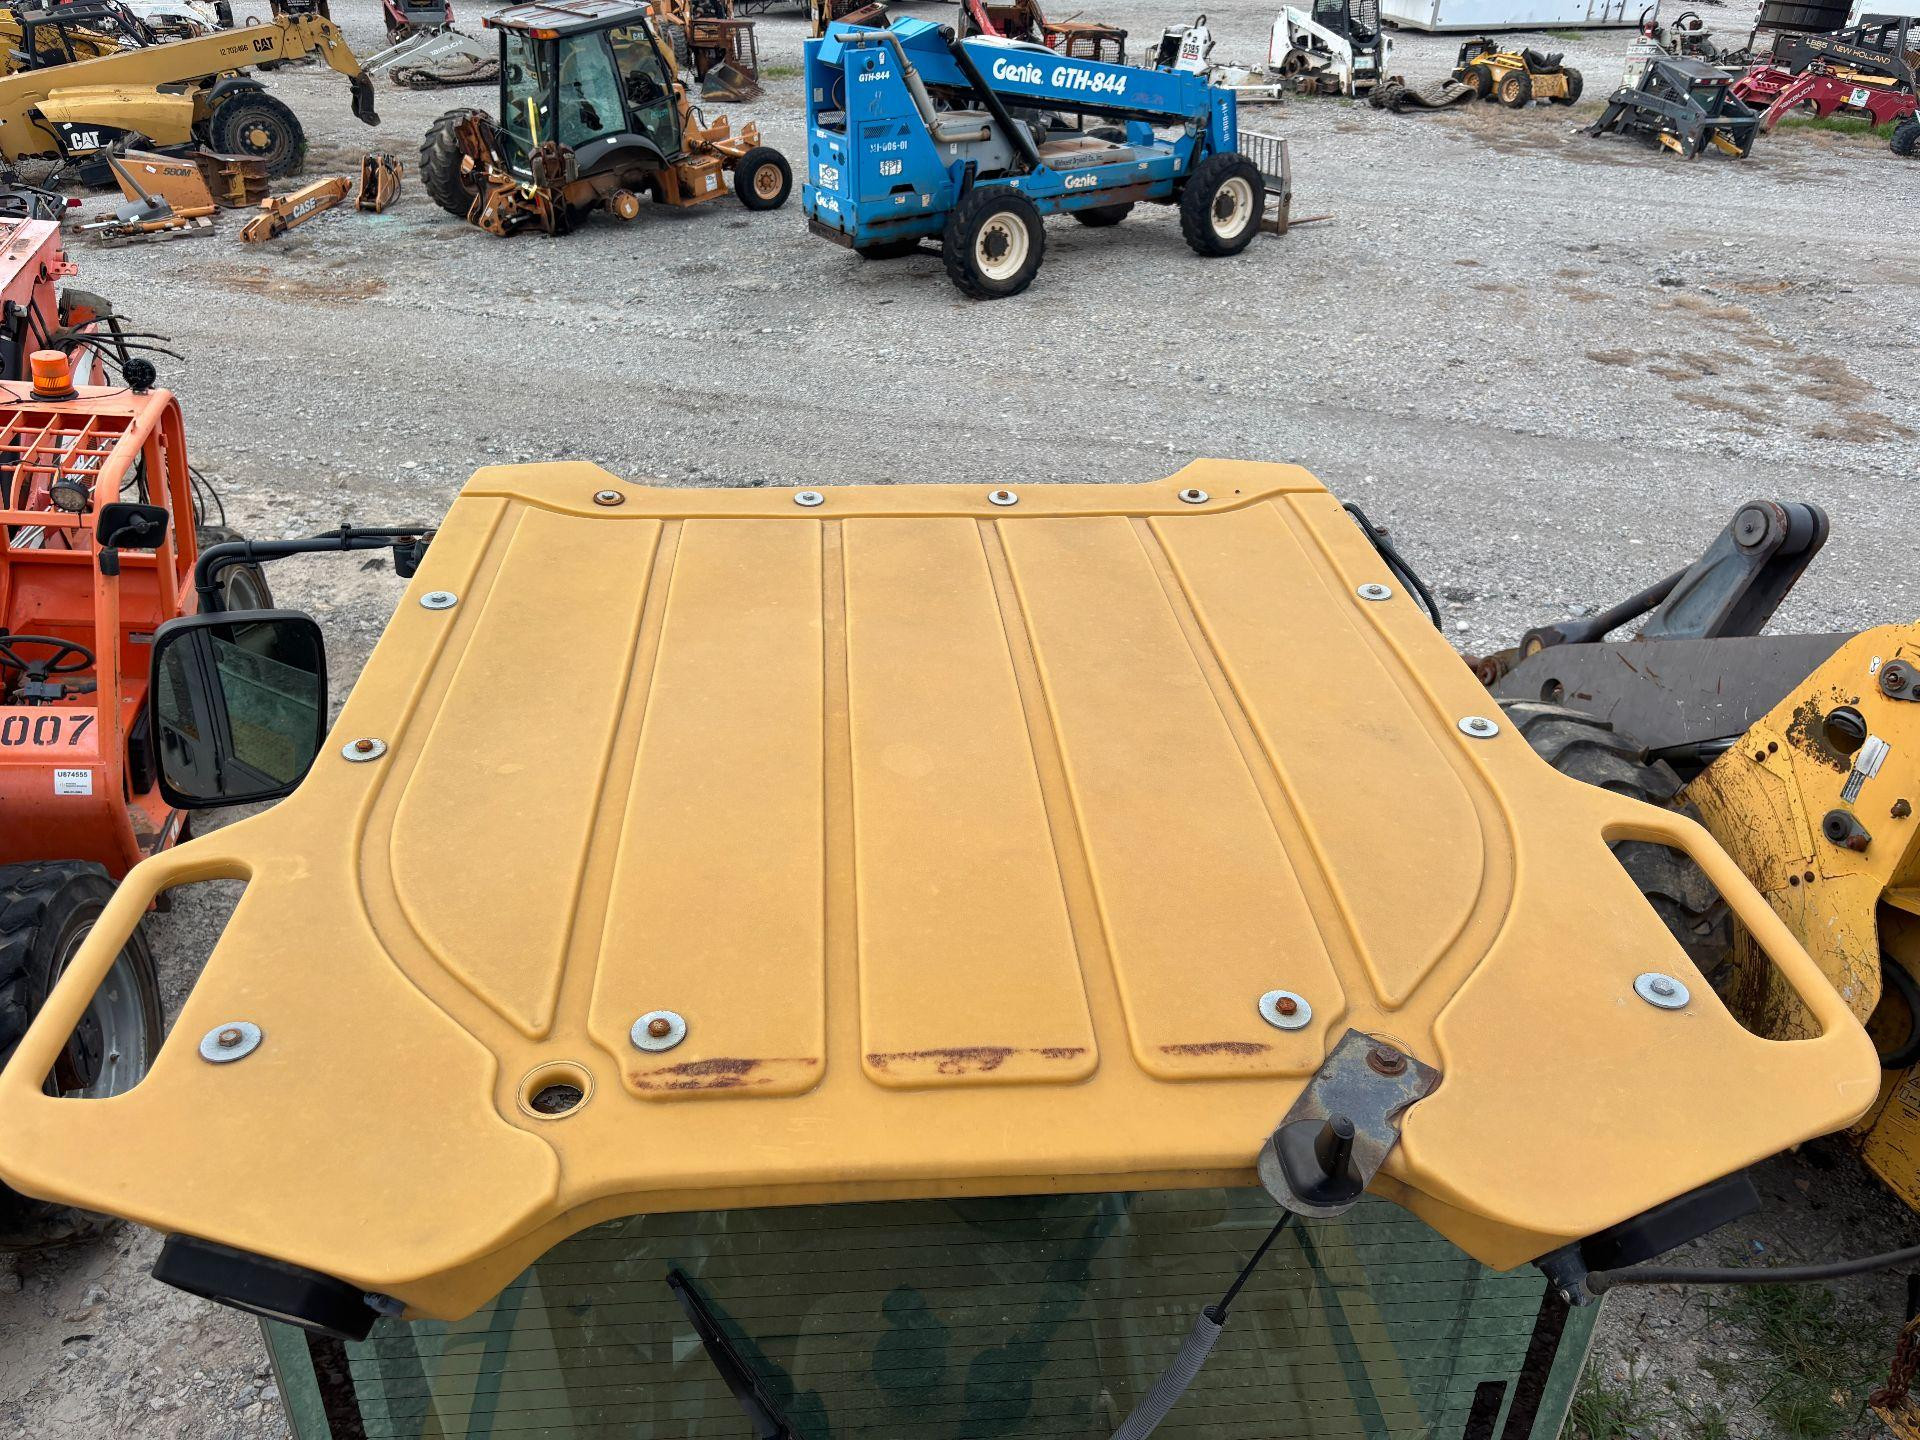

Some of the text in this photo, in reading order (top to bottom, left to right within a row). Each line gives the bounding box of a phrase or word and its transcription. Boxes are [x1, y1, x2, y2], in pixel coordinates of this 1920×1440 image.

[253, 37, 274, 52] CAT
[1832, 44, 1891, 64] NEW HOLLAND
[859, 71, 890, 82] GTH-844
[992, 58, 1128, 95] Genie GTH-844
[1779, 84, 1815, 109] TAKEUCHI
[70, 131, 100, 151] CAT
[1064, 173, 1098, 189] Genie
[293, 197, 316, 218] CASE
[1, 715, 94, 745] 007
